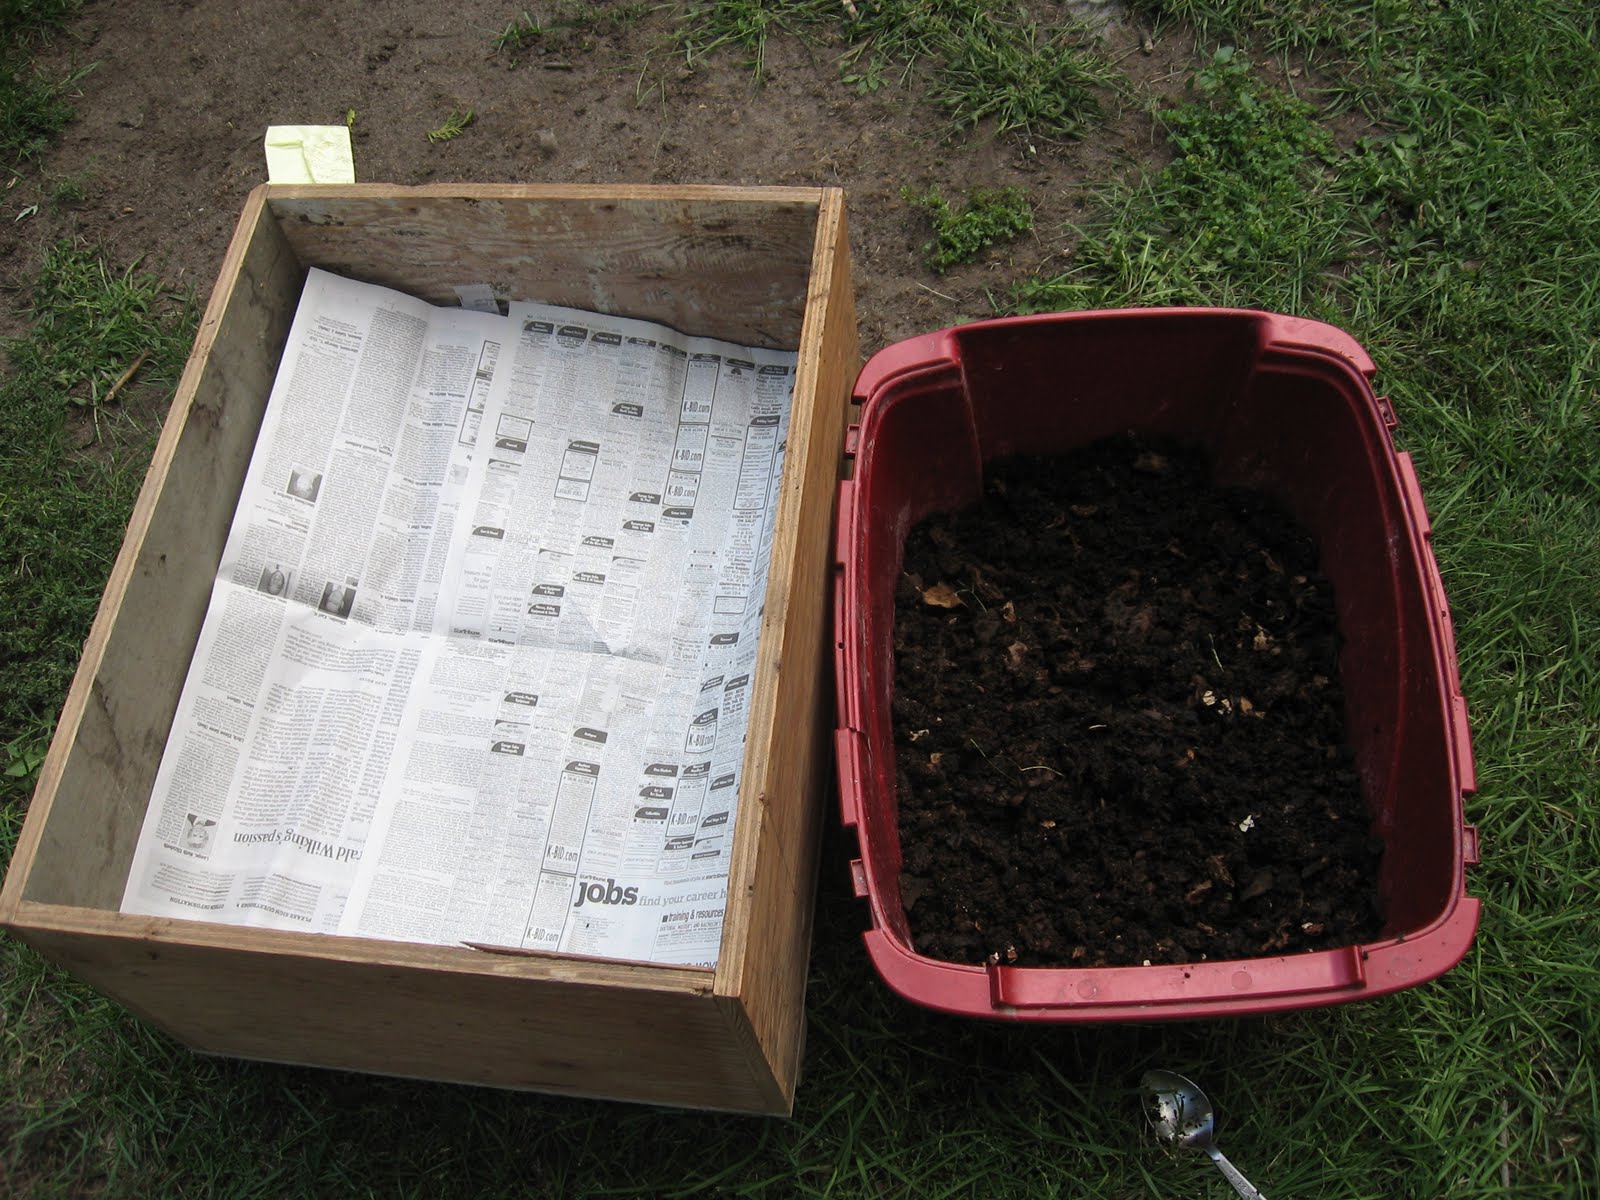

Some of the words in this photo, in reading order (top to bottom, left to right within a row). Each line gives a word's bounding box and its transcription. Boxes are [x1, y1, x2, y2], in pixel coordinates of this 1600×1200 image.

[674, 449, 702, 461] K-BID.com
[668, 485, 696, 498] K-BID.com
[688, 733, 715, 747] K-BID.com
[670, 813, 698, 826] K-BID.com
[234, 829, 276, 847] passion
[276, 829, 334, 859] Wilking's
[547, 845, 578, 862] K-BID.com
[573, 878, 639, 907] jobs
[638, 895, 661, 906] find
[661, 893, 685, 907] your
[686, 891, 719, 902] career
[169, 897, 211, 910] INFORMATION
[274, 908, 289, 918] SIGN
[289, 913, 313, 923] PLEASE
[668, 910, 690, 922] training
[690, 909, 695, 919] &
[695, 908, 725, 919] resources
[526, 928, 559, 942] K-BID.com
